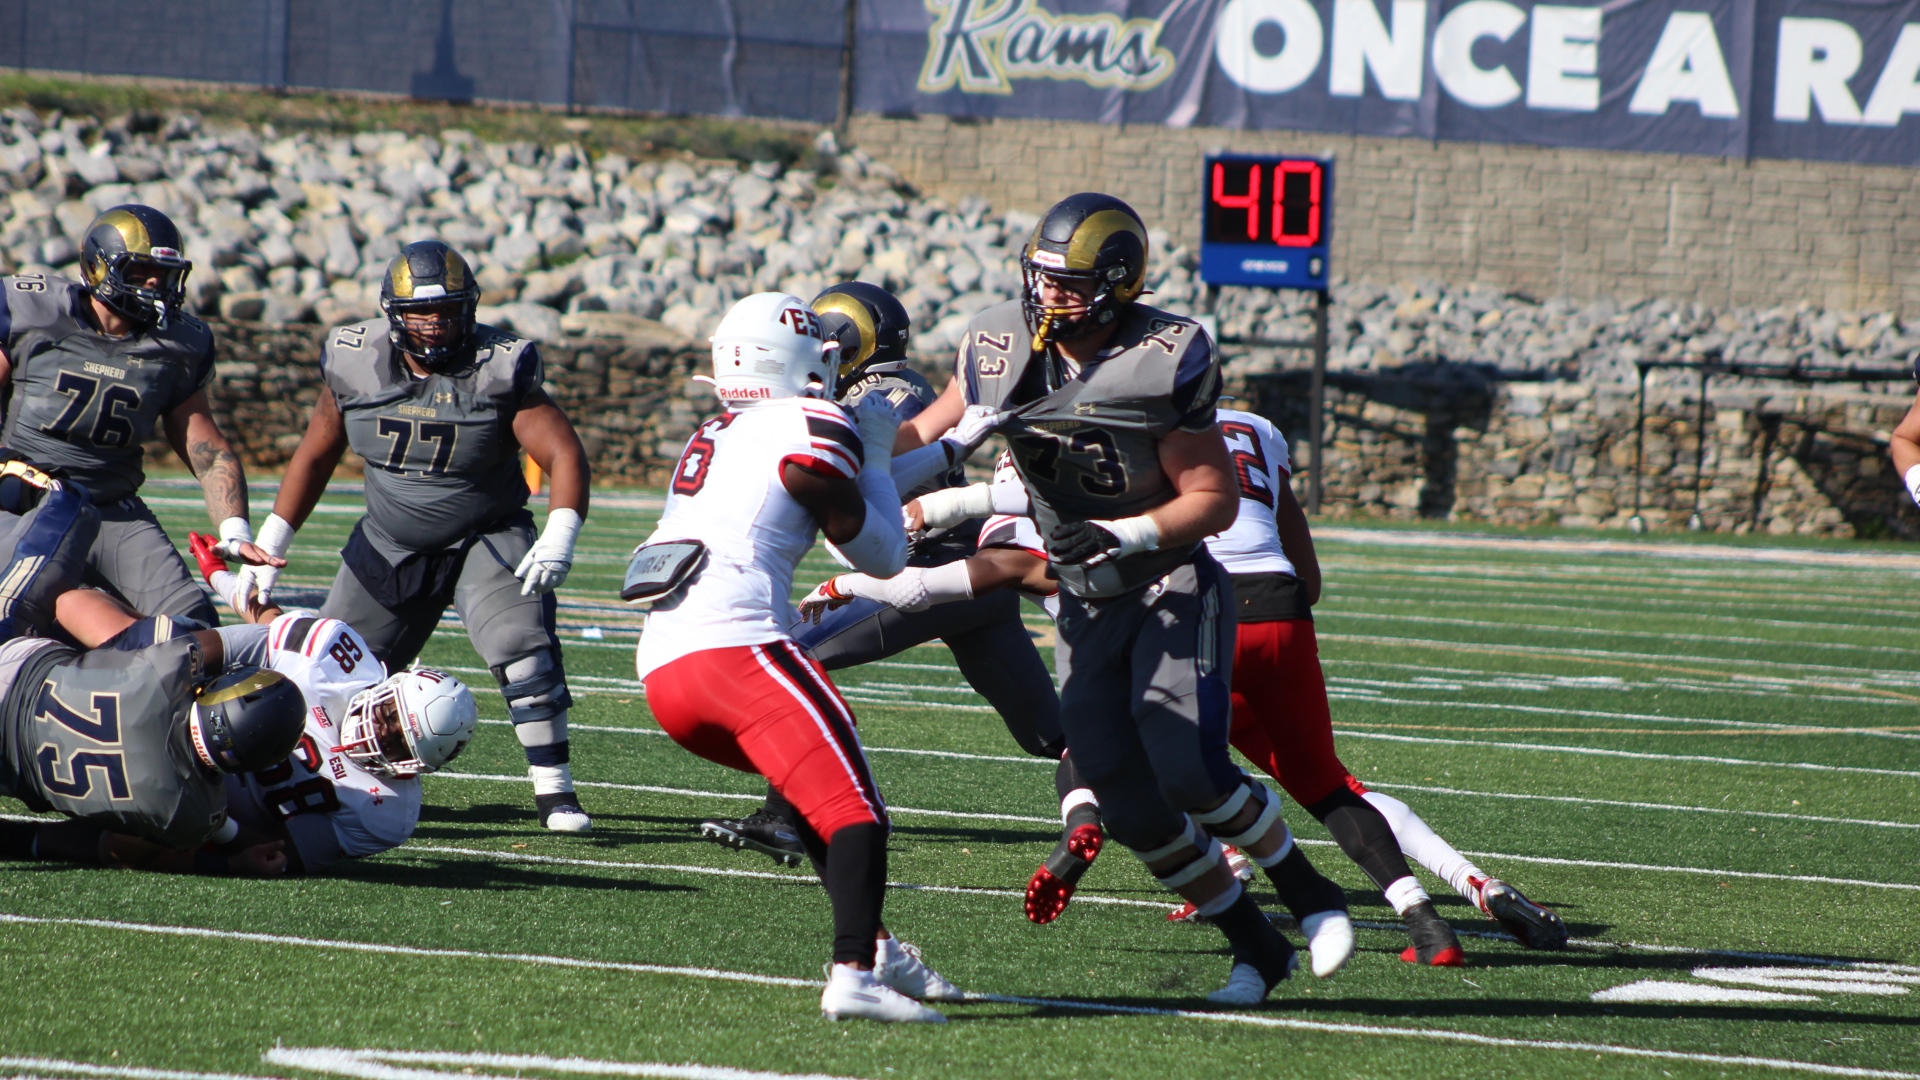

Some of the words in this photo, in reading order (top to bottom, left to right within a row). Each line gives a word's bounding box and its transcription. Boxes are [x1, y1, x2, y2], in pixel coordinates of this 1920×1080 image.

[918, 0, 1176, 94] Rams
[1215, 0, 1602, 111] ONCE
[1628, 11, 1740, 118] A
[1212, 161, 1321, 248] 40
[83, 361, 126, 380] SHEPHERD
[735, 346, 741, 357] 6
[975, 331, 1014, 379] 73
[40, 369, 142, 447] 76
[398, 404, 437, 418] SHEPHERD
[719, 387, 771, 399] Riddell
[376, 415, 459, 477] 77
[672, 411, 739, 497] 6
[1013, 426, 1130, 498] 73
[329, 631, 364, 674] 68
[34, 679, 134, 801] 75
[328, 755, 348, 780] ESU
